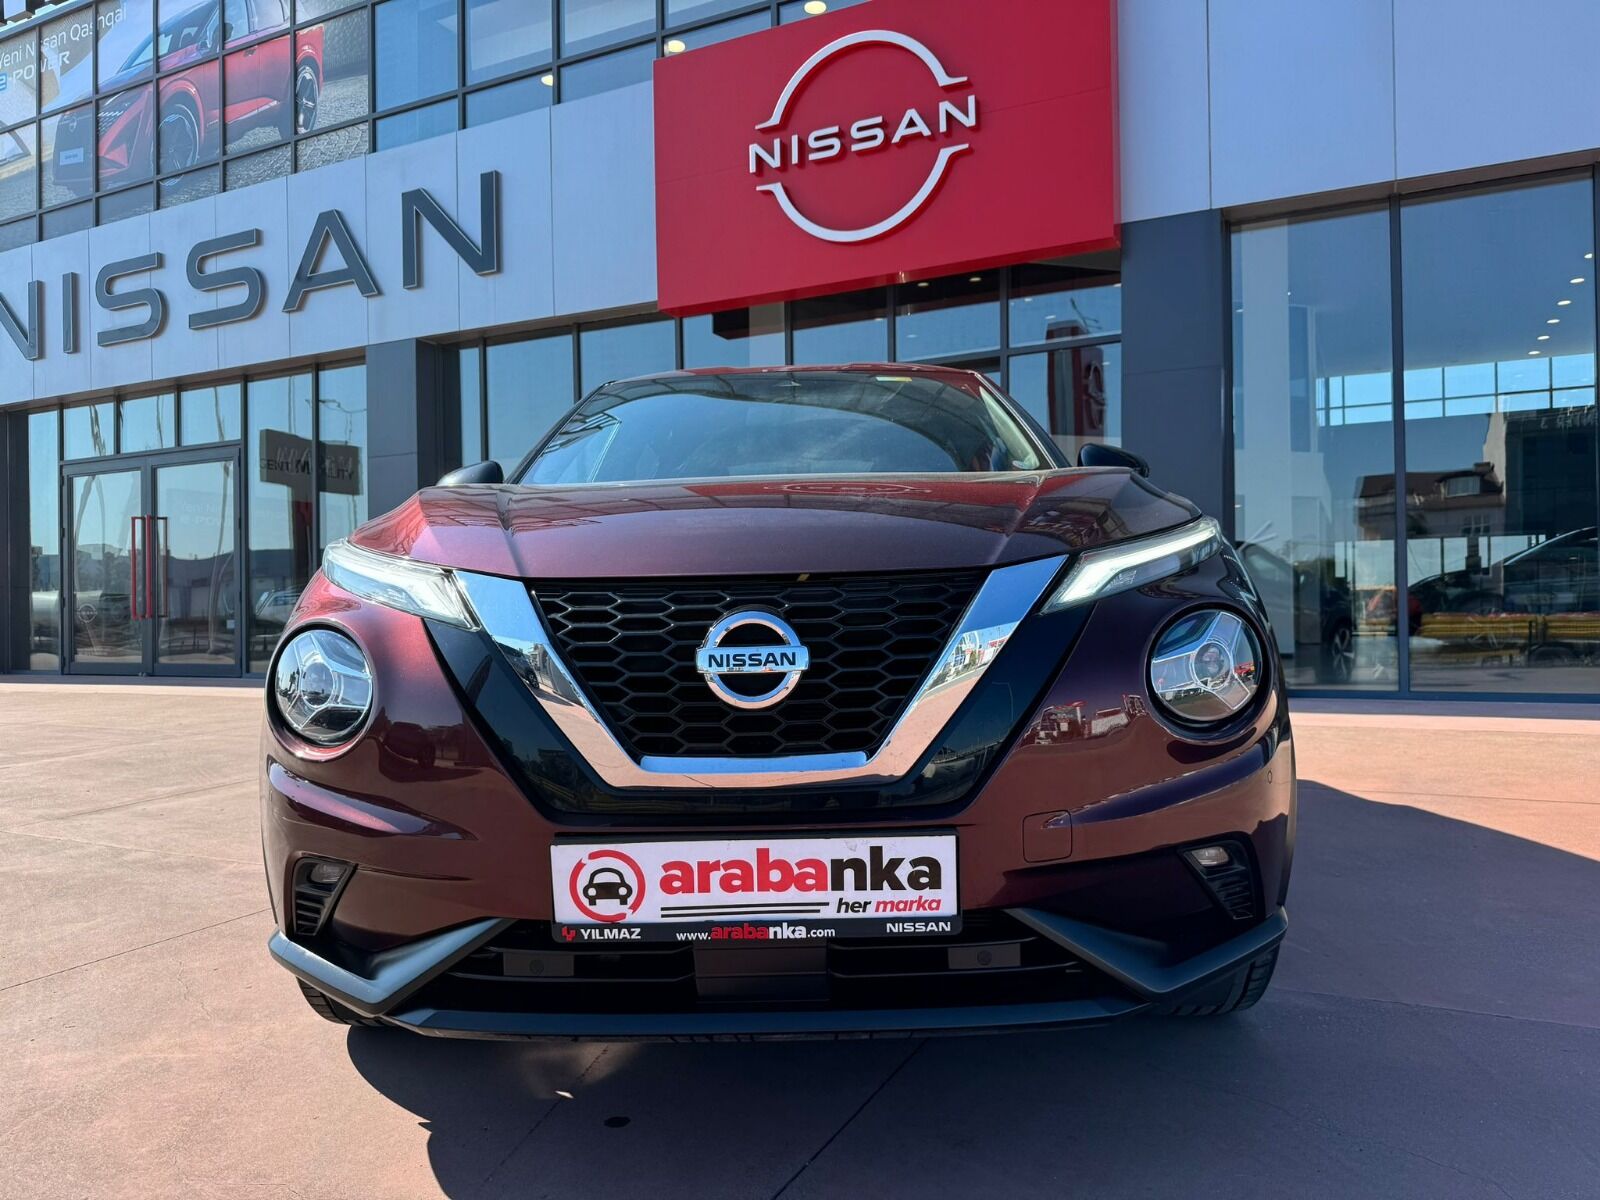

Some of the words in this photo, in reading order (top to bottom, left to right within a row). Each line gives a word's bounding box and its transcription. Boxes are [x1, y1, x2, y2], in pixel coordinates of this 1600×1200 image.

[749, 94, 977, 173] NISSAN
[0, 169, 502, 361] NISSAN
[708, 652, 796, 668] NISSAN
[659, 845, 942, 895] arabanka
[836, 897, 872, 914] her
[874, 896, 942, 913] marka
[580, 927, 642, 940] YILMAZ
[676, 922, 836, 942] www.arabanka.com
[886, 921, 951, 933] NISSAN
